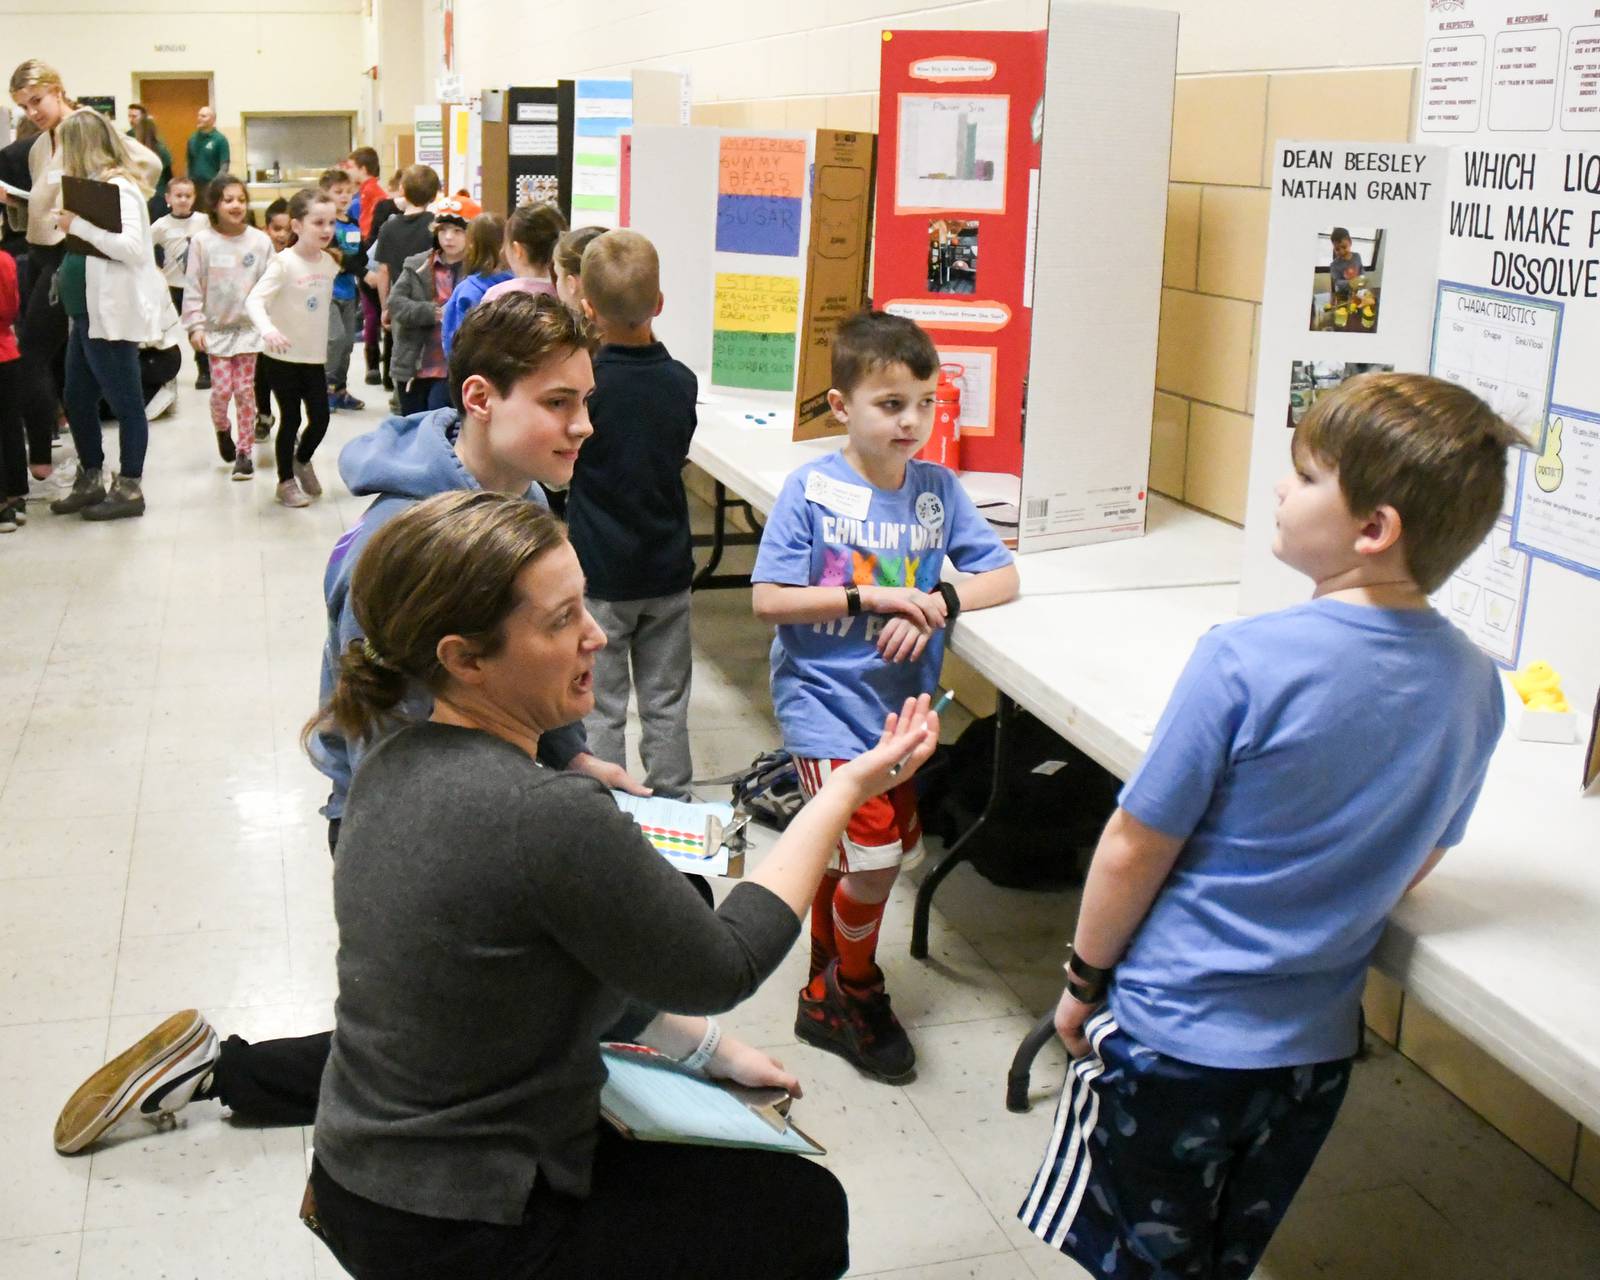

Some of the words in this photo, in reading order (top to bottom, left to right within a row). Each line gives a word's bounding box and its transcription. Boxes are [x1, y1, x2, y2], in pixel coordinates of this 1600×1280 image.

[1283, 150, 1332, 169] DEAN
[1345, 152, 1426, 173] BEESLEY
[1464, 151, 1536, 191] WHICH
[1281, 179, 1357, 201] NATHAN
[1367, 181, 1431, 201] GRANT
[724, 207, 795, 232] SUGAR
[1449, 201, 1494, 240] WILL
[1504, 205, 1574, 247] MAKE
[1491, 250, 1600, 298] DISSOLVE
[1458, 297, 1537, 326] CHARACTERISTICS
[822, 516, 906, 550] CHILLIN'
